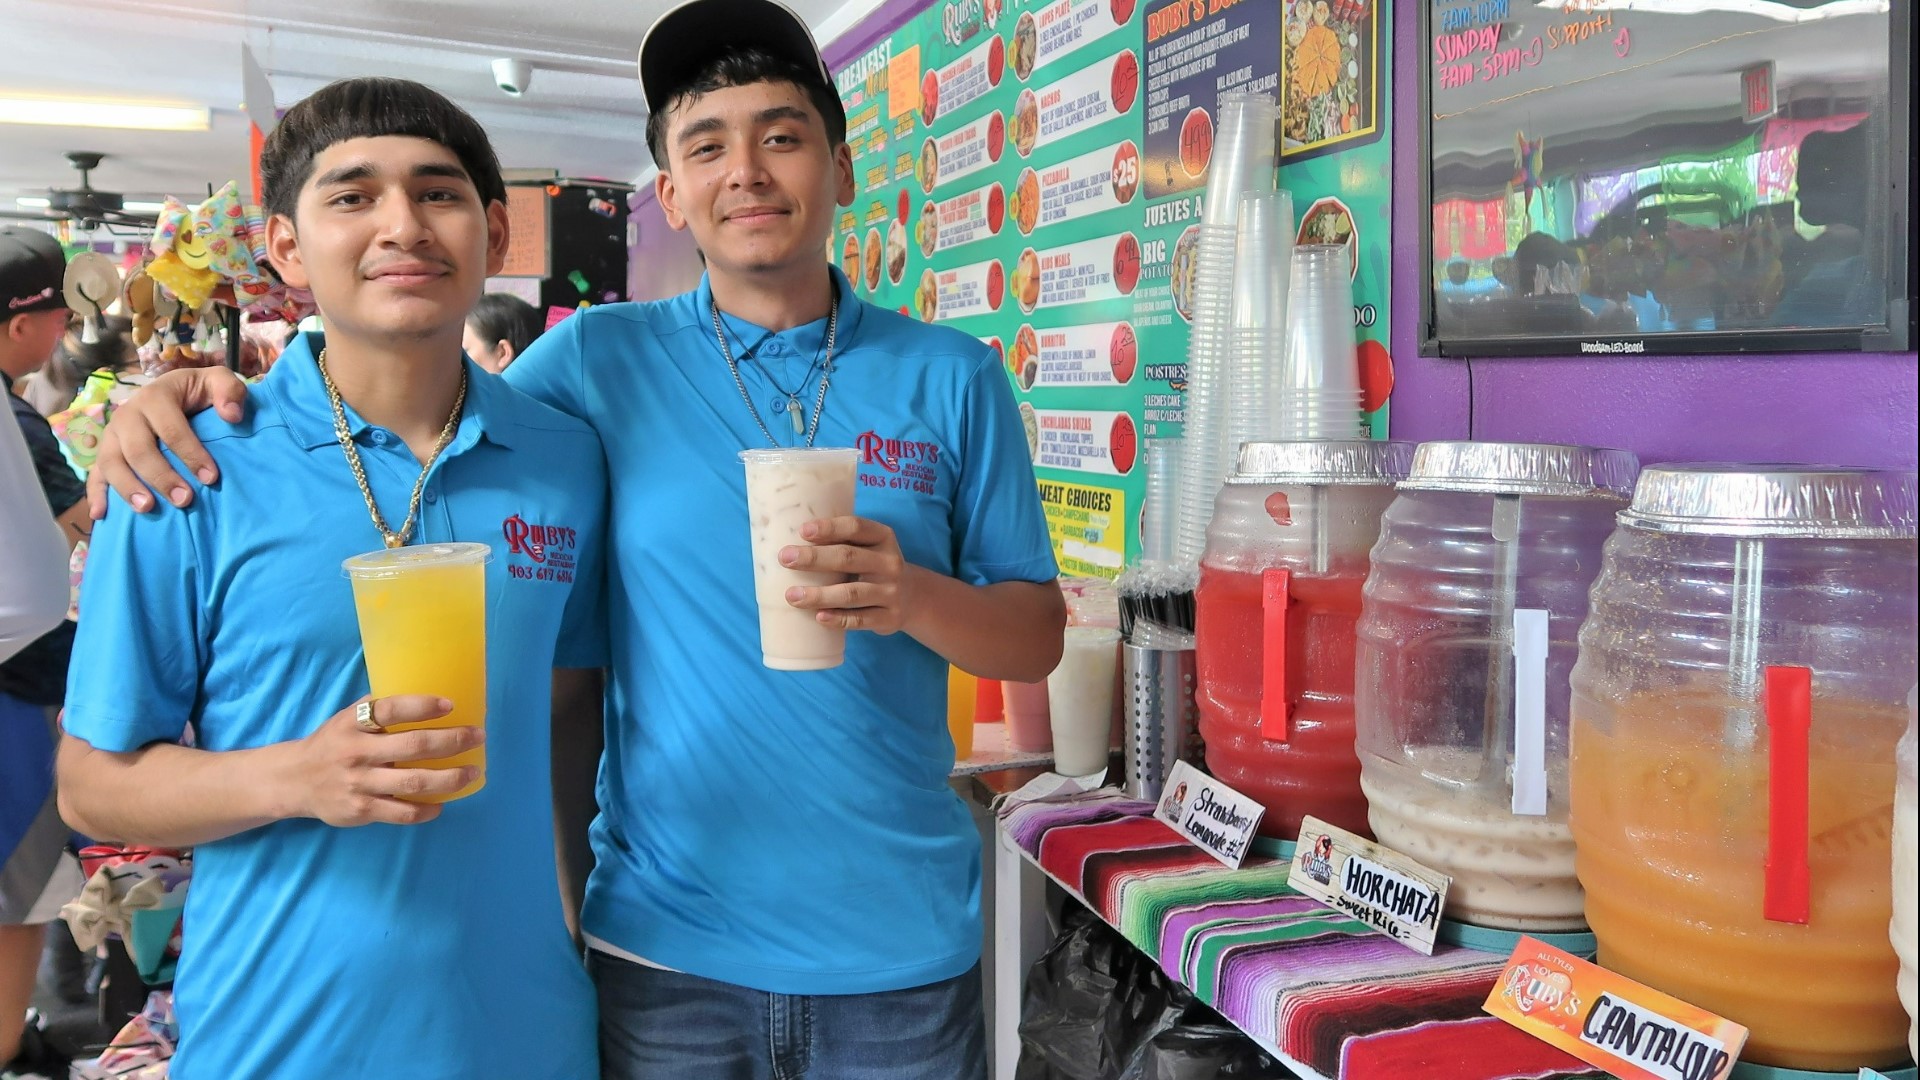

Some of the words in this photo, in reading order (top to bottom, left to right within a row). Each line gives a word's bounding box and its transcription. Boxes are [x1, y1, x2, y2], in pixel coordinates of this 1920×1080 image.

[1434, 22, 1503, 65] SUNDAY
[838, 37, 892, 97] BREAKFAST
[1113, 157, 1136, 188] $25
[1144, 197, 1190, 228] JUEVES
[1042, 256, 1053, 270] KIDS
[1055, 252, 1071, 267] MEALS
[1142, 239, 1166, 265] BIG
[1140, 262, 1174, 280] POTATO
[1041, 334, 1066, 348] BURRITOS
[1145, 364, 1186, 379] POSTRES
[1144, 394, 1148, 406] 3
[1148, 394, 1167, 406] LECHES
[1167, 394, 1181, 407] CAKE
[1041, 416, 1071, 430] ENCHILADAS
[1072, 417, 1091, 431] SUIZAS
[1144, 424, 1156, 435] FLAN
[860, 473, 886, 488] 903
[890, 477, 910, 490] 617
[913, 480, 934, 496] 6816
[1066, 488, 1112, 512] CHOICES
[508, 564, 533, 580] 903
[536, 567, 554, 582] 617
[557, 570, 573, 584] 6816
[1346, 858, 1440, 930] HORCHATA
[1373, 908, 1401, 939] Rice
[1533, 964, 1564, 984] LOVES
[1537, 952, 1550, 962] ALL
[1553, 956, 1575, 974] TYLER
